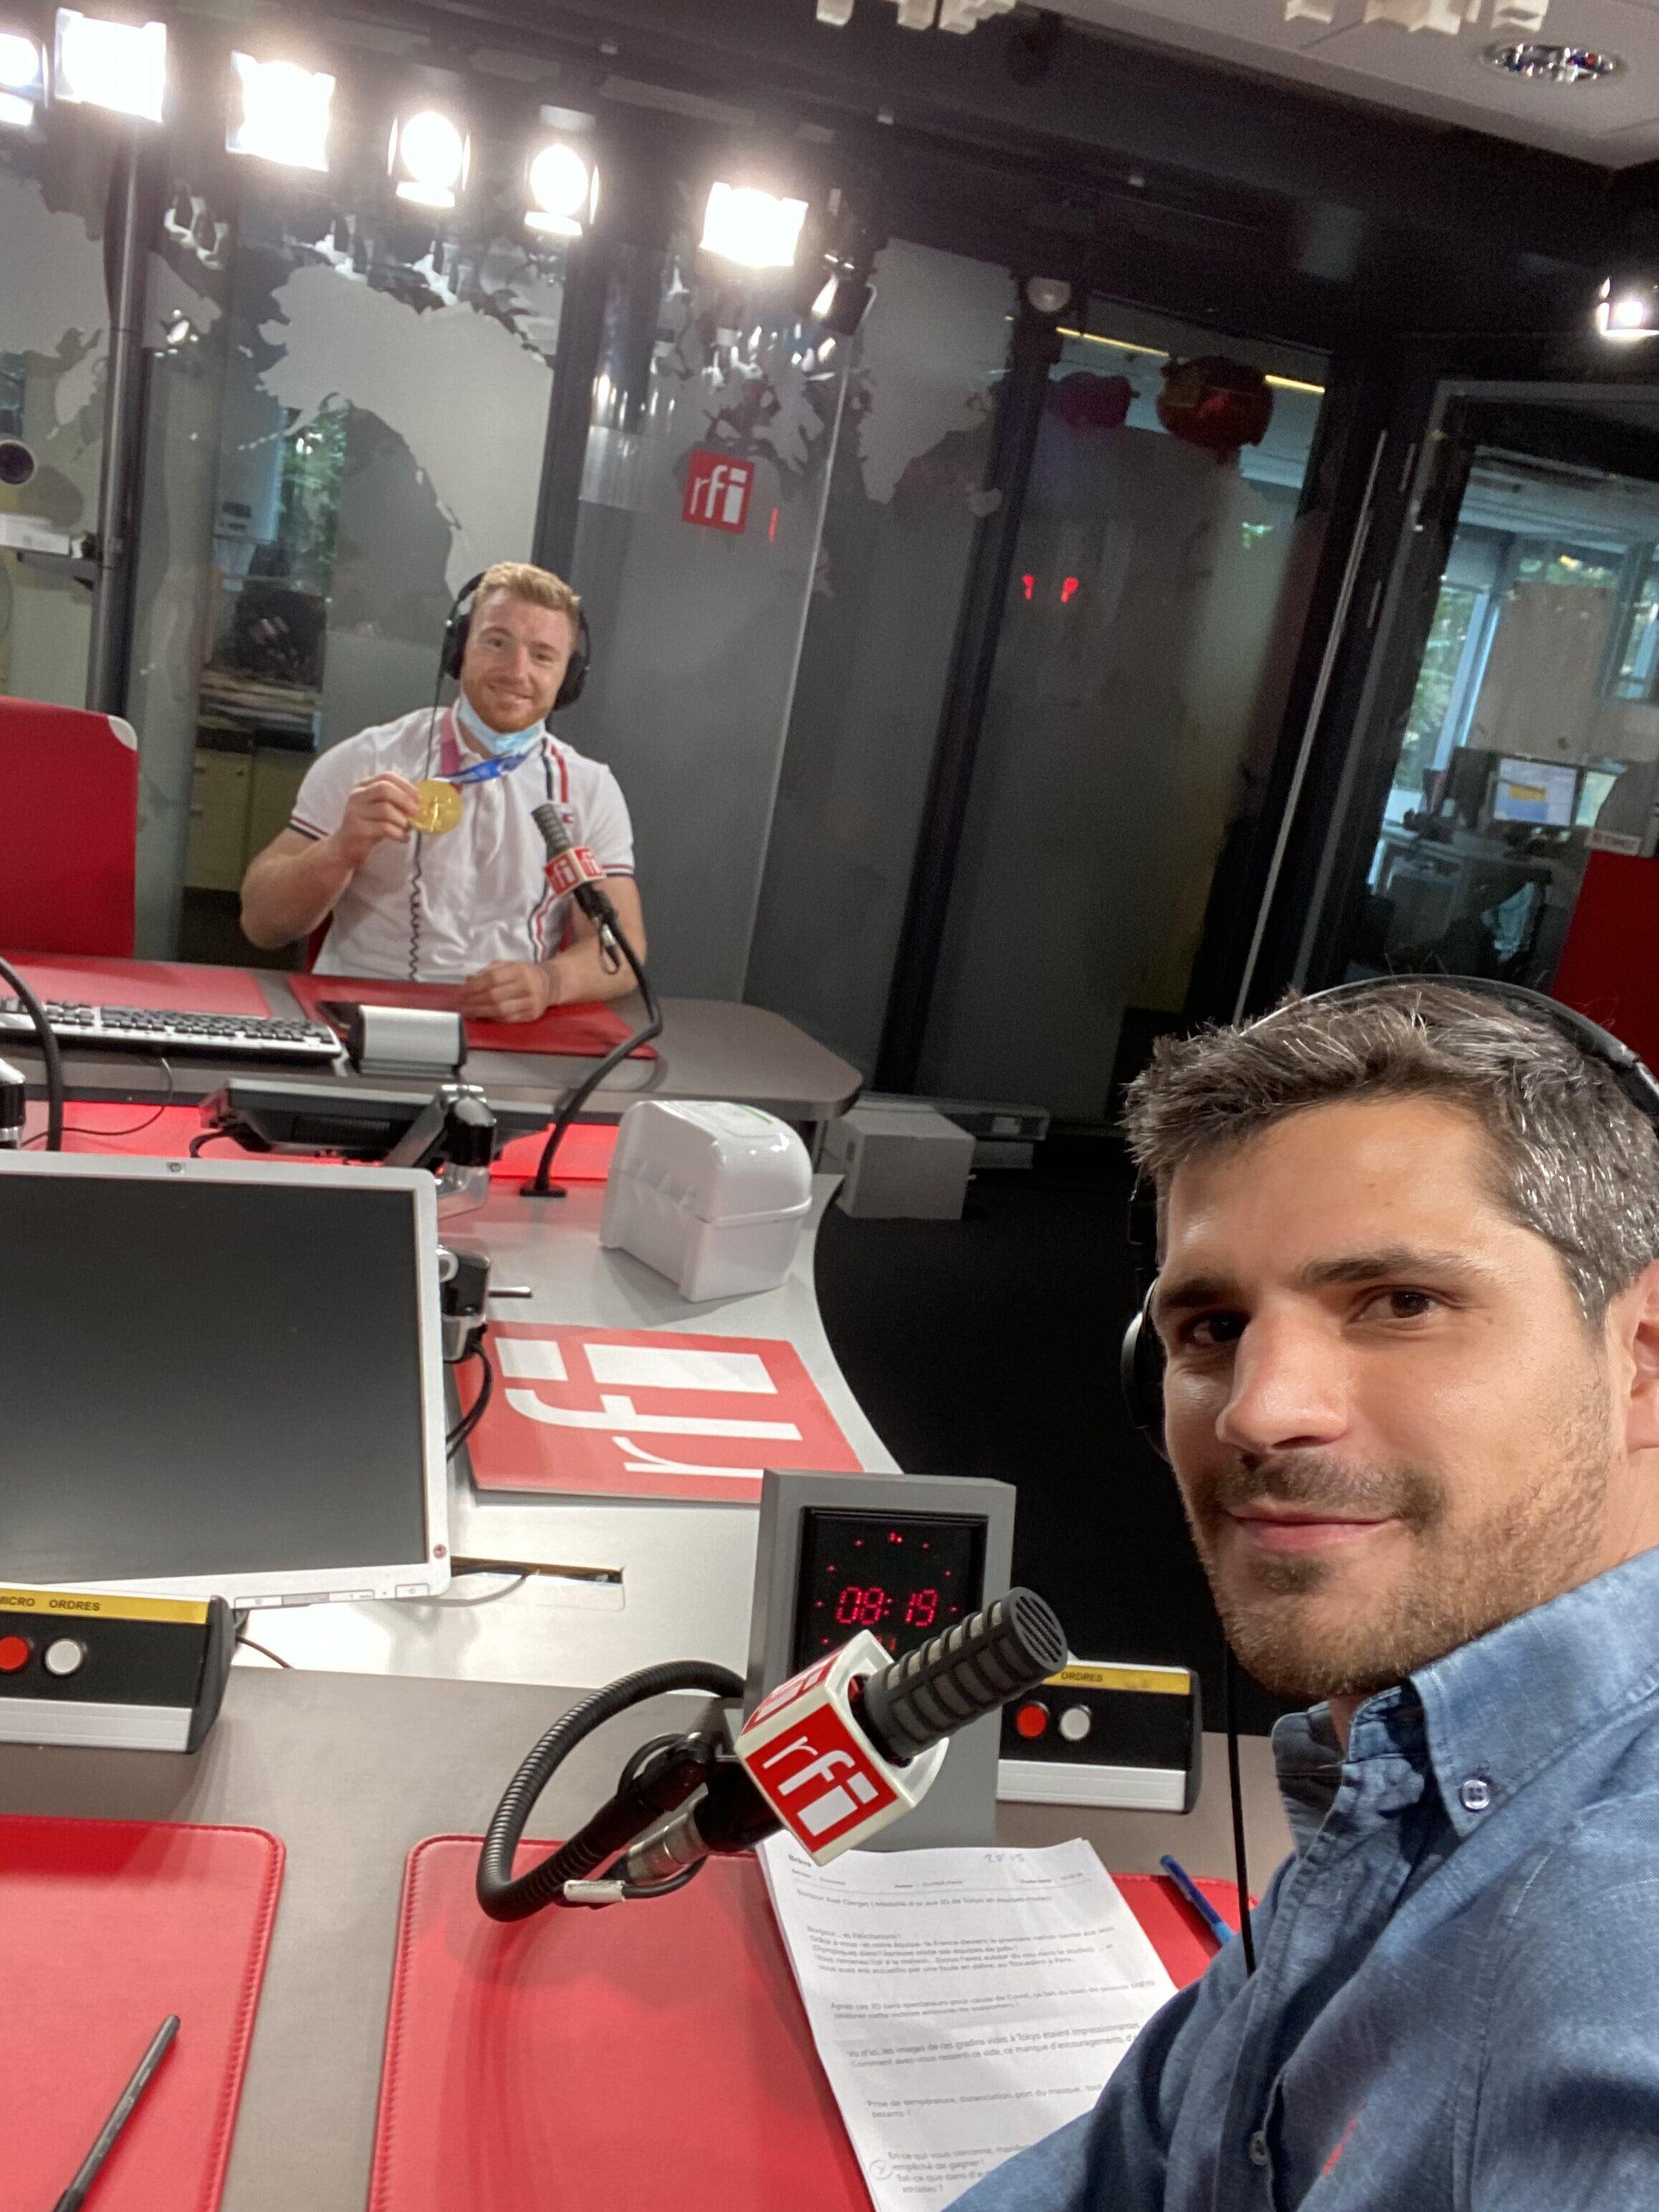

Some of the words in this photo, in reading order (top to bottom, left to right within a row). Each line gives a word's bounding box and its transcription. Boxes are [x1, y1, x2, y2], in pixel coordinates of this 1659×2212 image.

[690, 465, 747, 524] rfi
[494, 1337, 802, 1478] rfi
[49, 1599, 100, 1612] ORDRES
[1060, 1671, 1103, 1683] ORDRES
[762, 1735, 879, 1837] rfi
